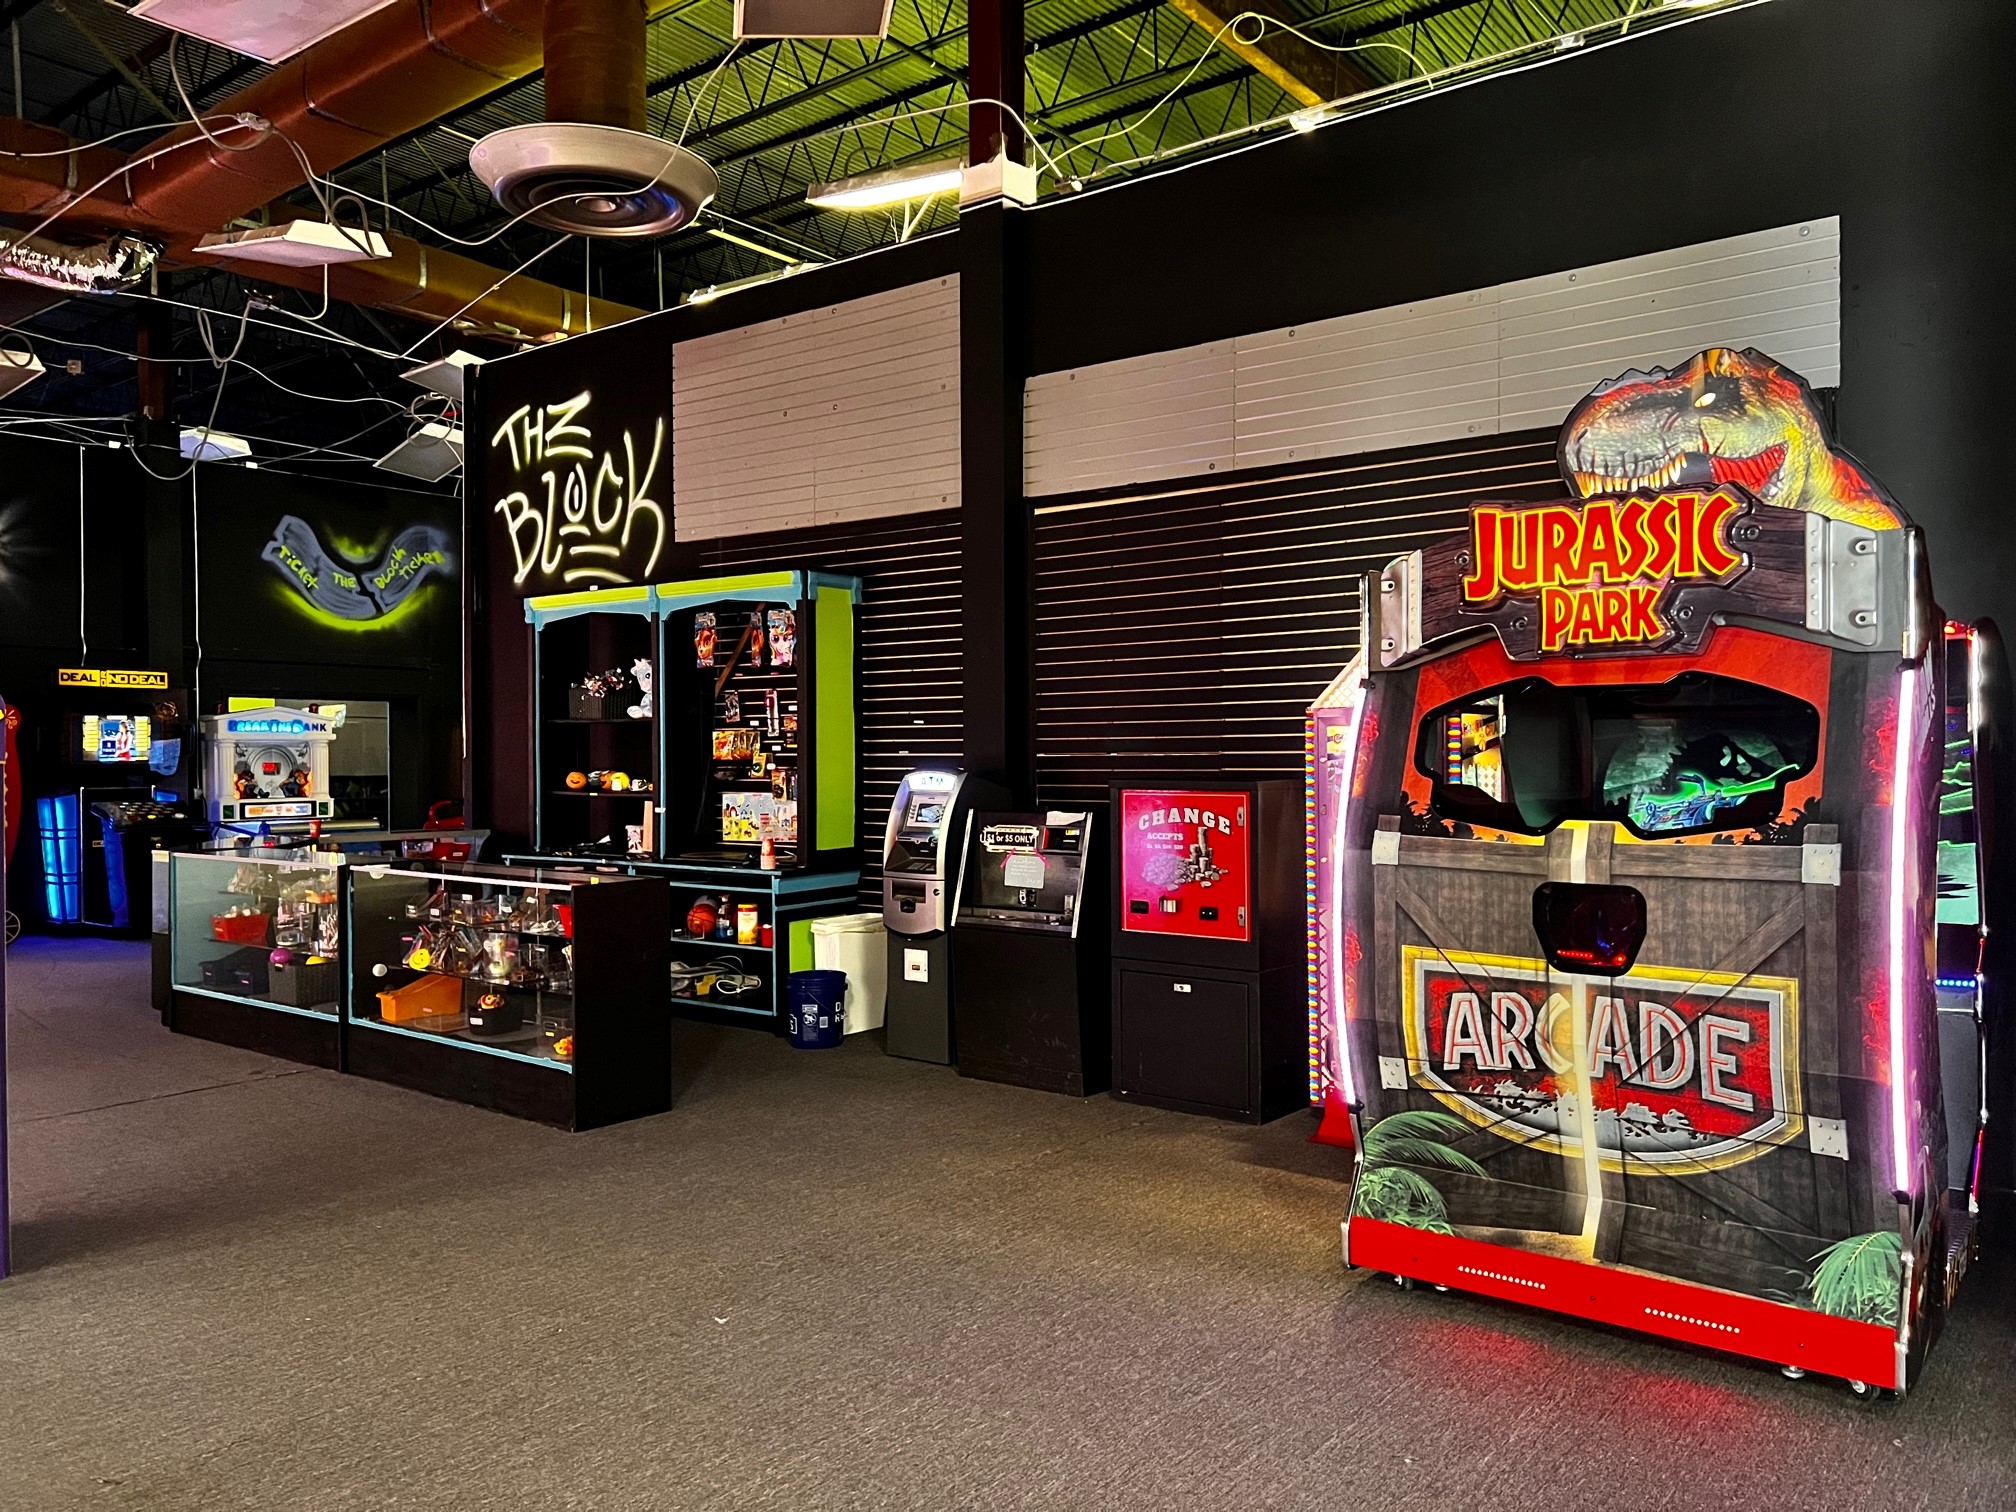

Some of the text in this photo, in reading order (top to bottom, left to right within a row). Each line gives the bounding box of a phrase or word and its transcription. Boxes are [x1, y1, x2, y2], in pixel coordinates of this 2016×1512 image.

[494, 416, 665, 585] BLOCK
[1463, 492, 1743, 601] JURASSIC
[333, 572, 357, 588] THE
[1541, 585, 1665, 651] PARK
[60, 672, 97, 682] DEAL
[109, 674, 129, 684] NO
[129, 674, 165, 684] DEAL
[292, 719, 328, 733] BANK
[921, 776, 944, 786] ATM
[1138, 807, 1231, 835] CHANGE
[1005, 834, 1013, 842] $5
[1014, 834, 1033, 843] ONLY
[1146, 832, 1184, 841] ACCEPTS
[1443, 991, 1754, 1112] ARCADE
